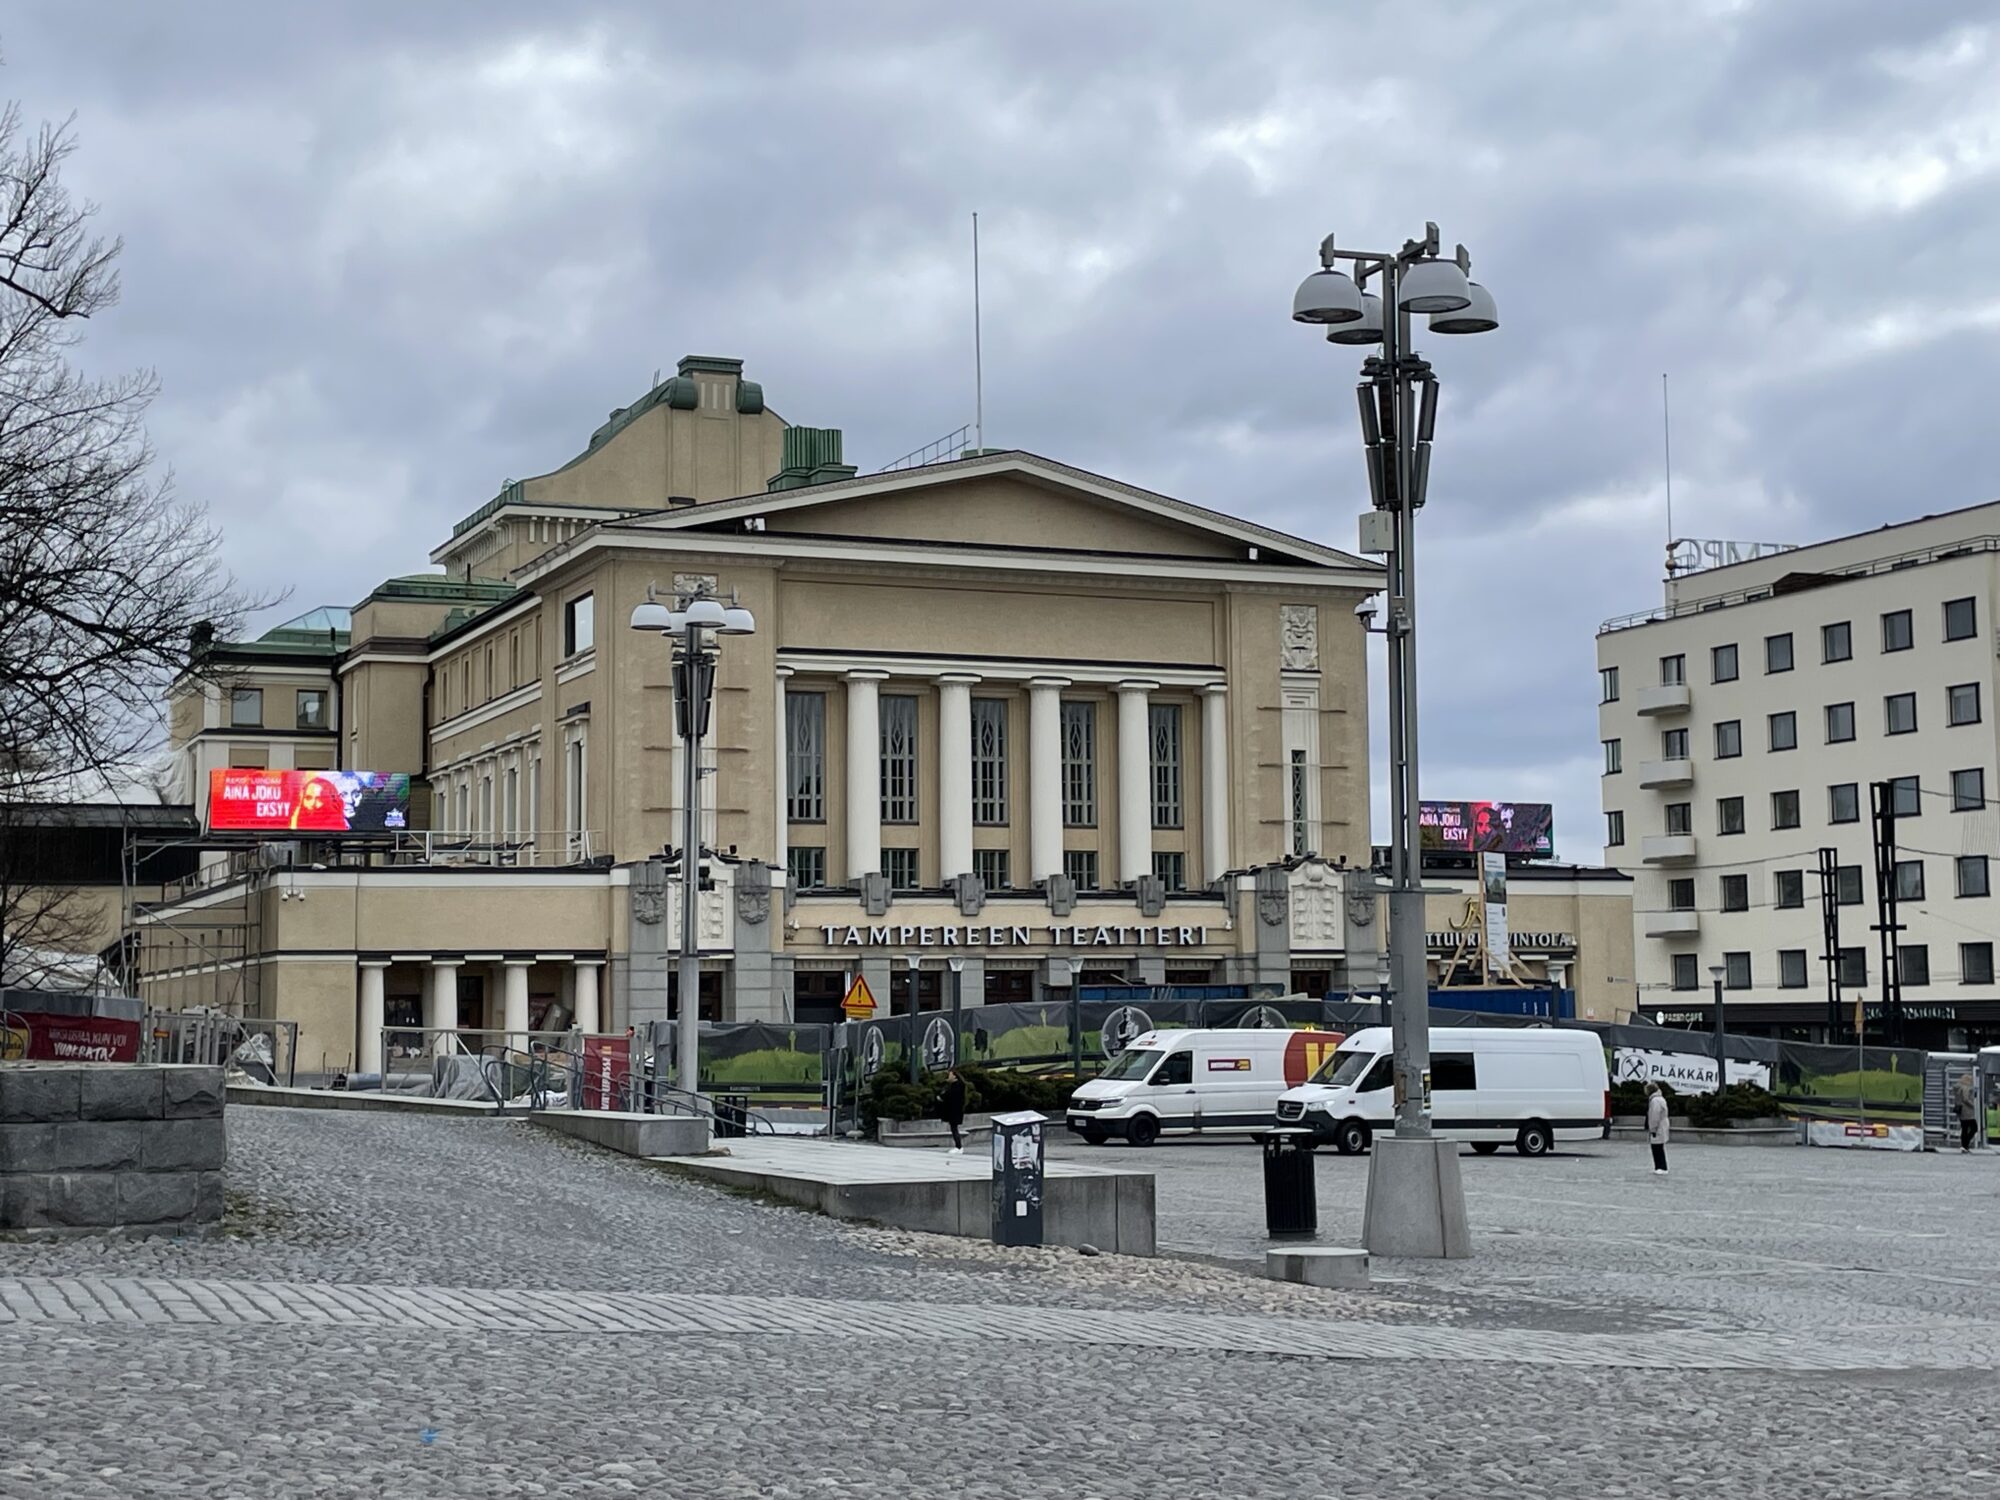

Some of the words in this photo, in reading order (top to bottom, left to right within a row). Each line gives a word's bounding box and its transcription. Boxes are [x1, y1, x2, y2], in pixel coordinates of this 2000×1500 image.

[223, 785, 250, 800] AINA
[251, 785, 282, 801] JOKU
[256, 802, 291, 817] EKSYY
[822, 925, 1031, 946] TAMPEREEN
[1050, 926, 1208, 946] TEATTERI
[1651, 1064, 1718, 1083] PLÄKKÄRI
